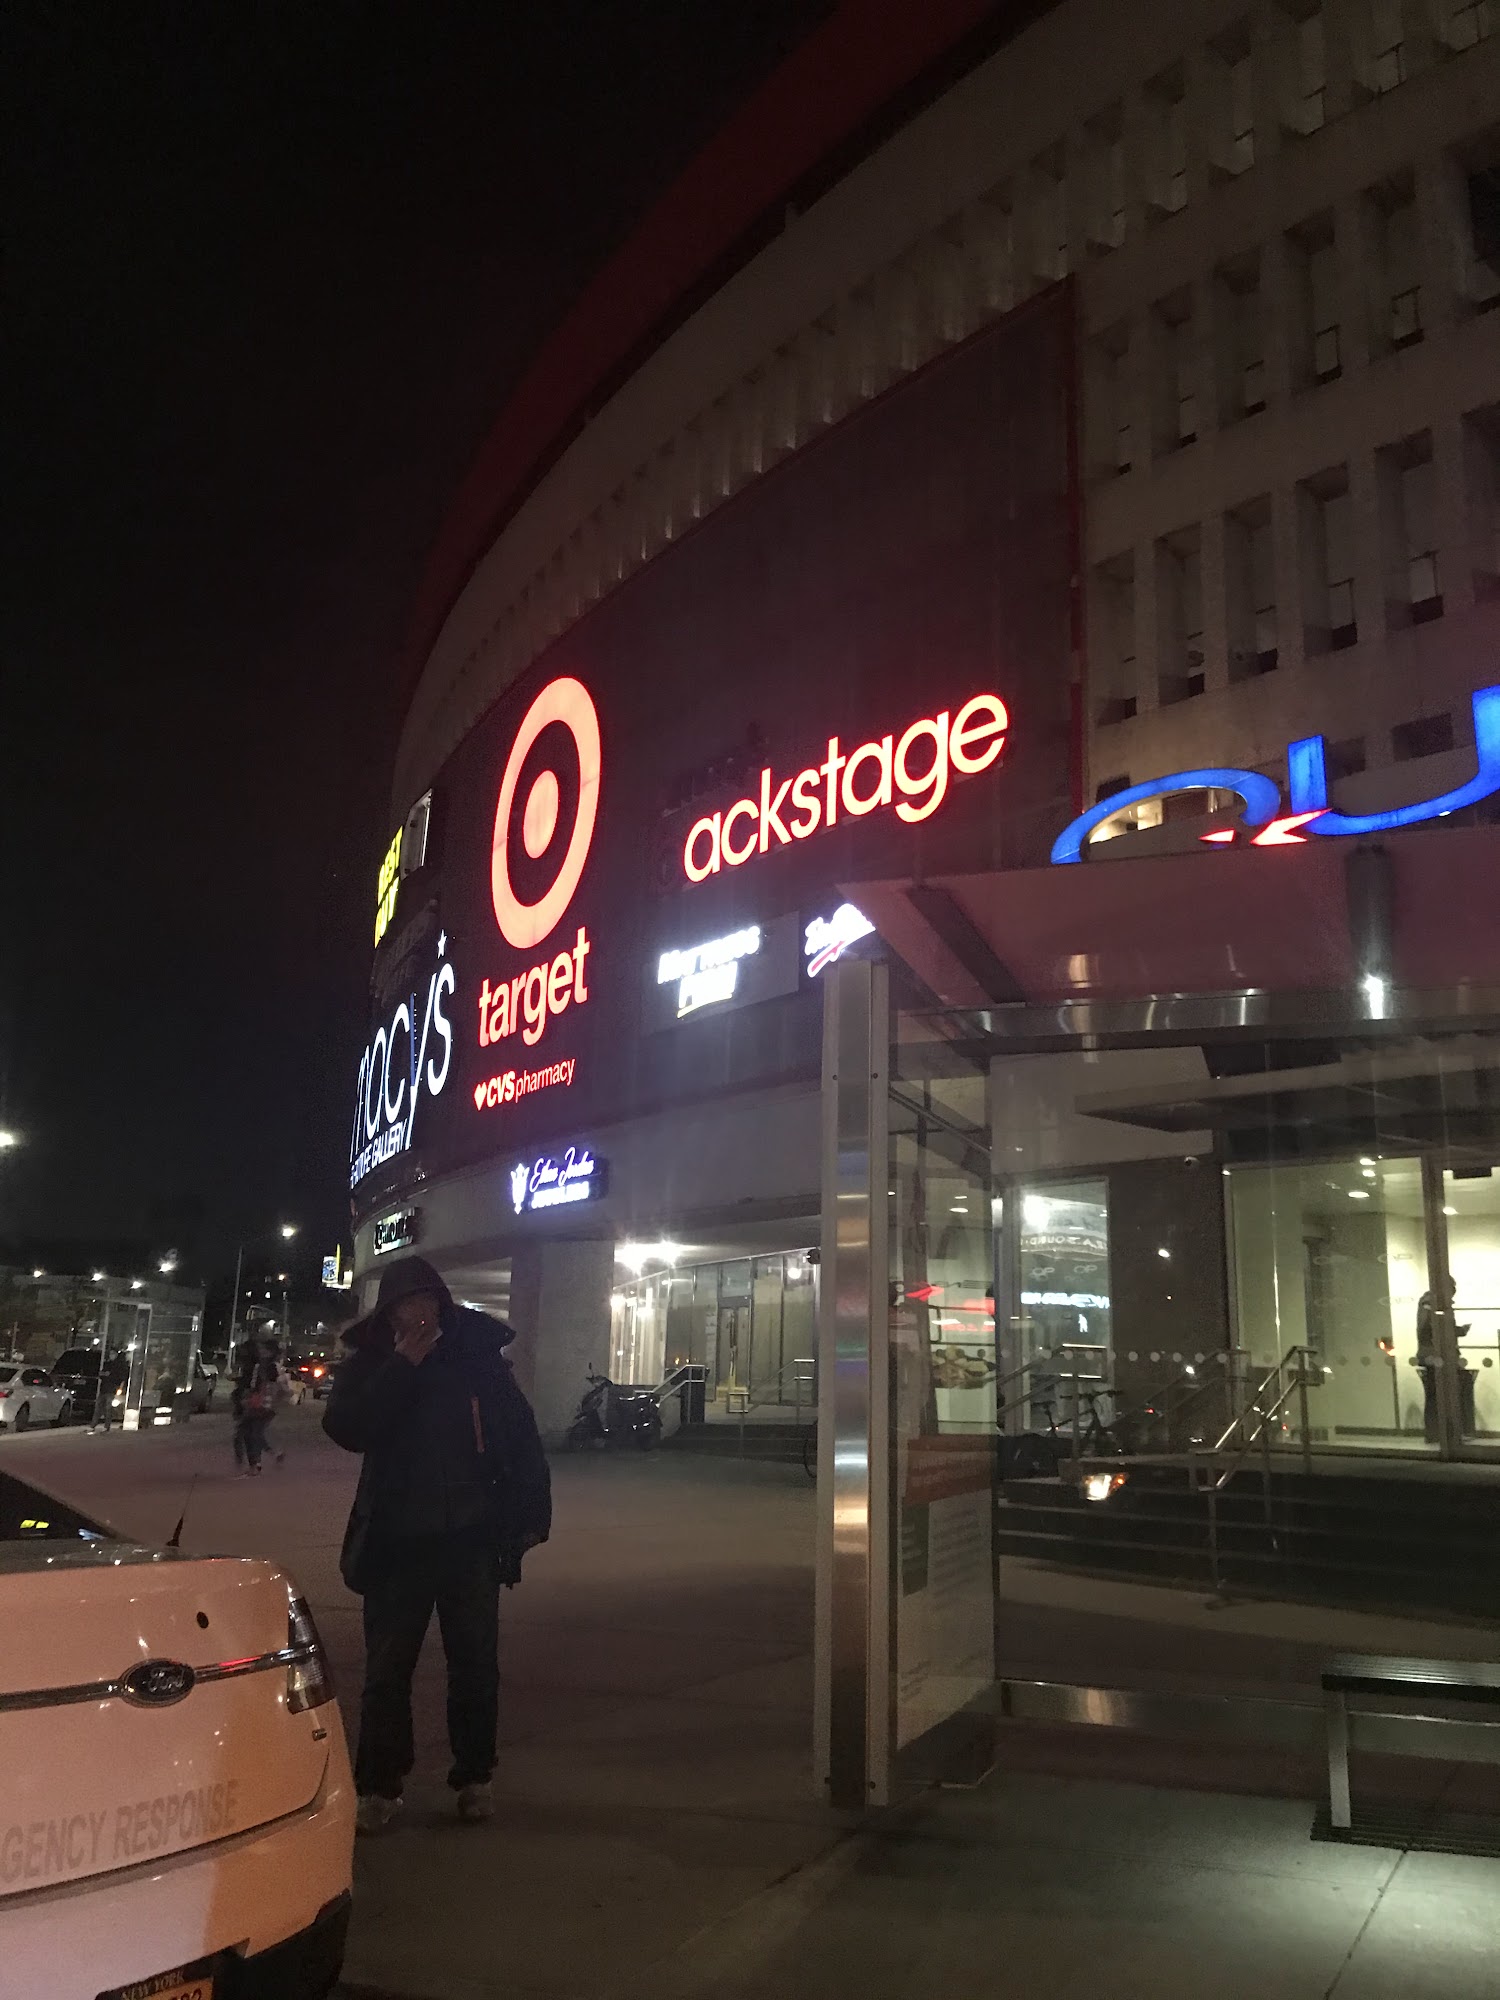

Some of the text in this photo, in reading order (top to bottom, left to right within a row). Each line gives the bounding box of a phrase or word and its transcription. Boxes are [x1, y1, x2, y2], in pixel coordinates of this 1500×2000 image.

[684, 693, 1009, 883] ackstage
[478, 926, 591, 1047] target
[1, 1778, 239, 1884] GENCY RESPONSE
[120, 1981, 153, 2000] NEW
[154, 1970, 186, 1993] YORK
